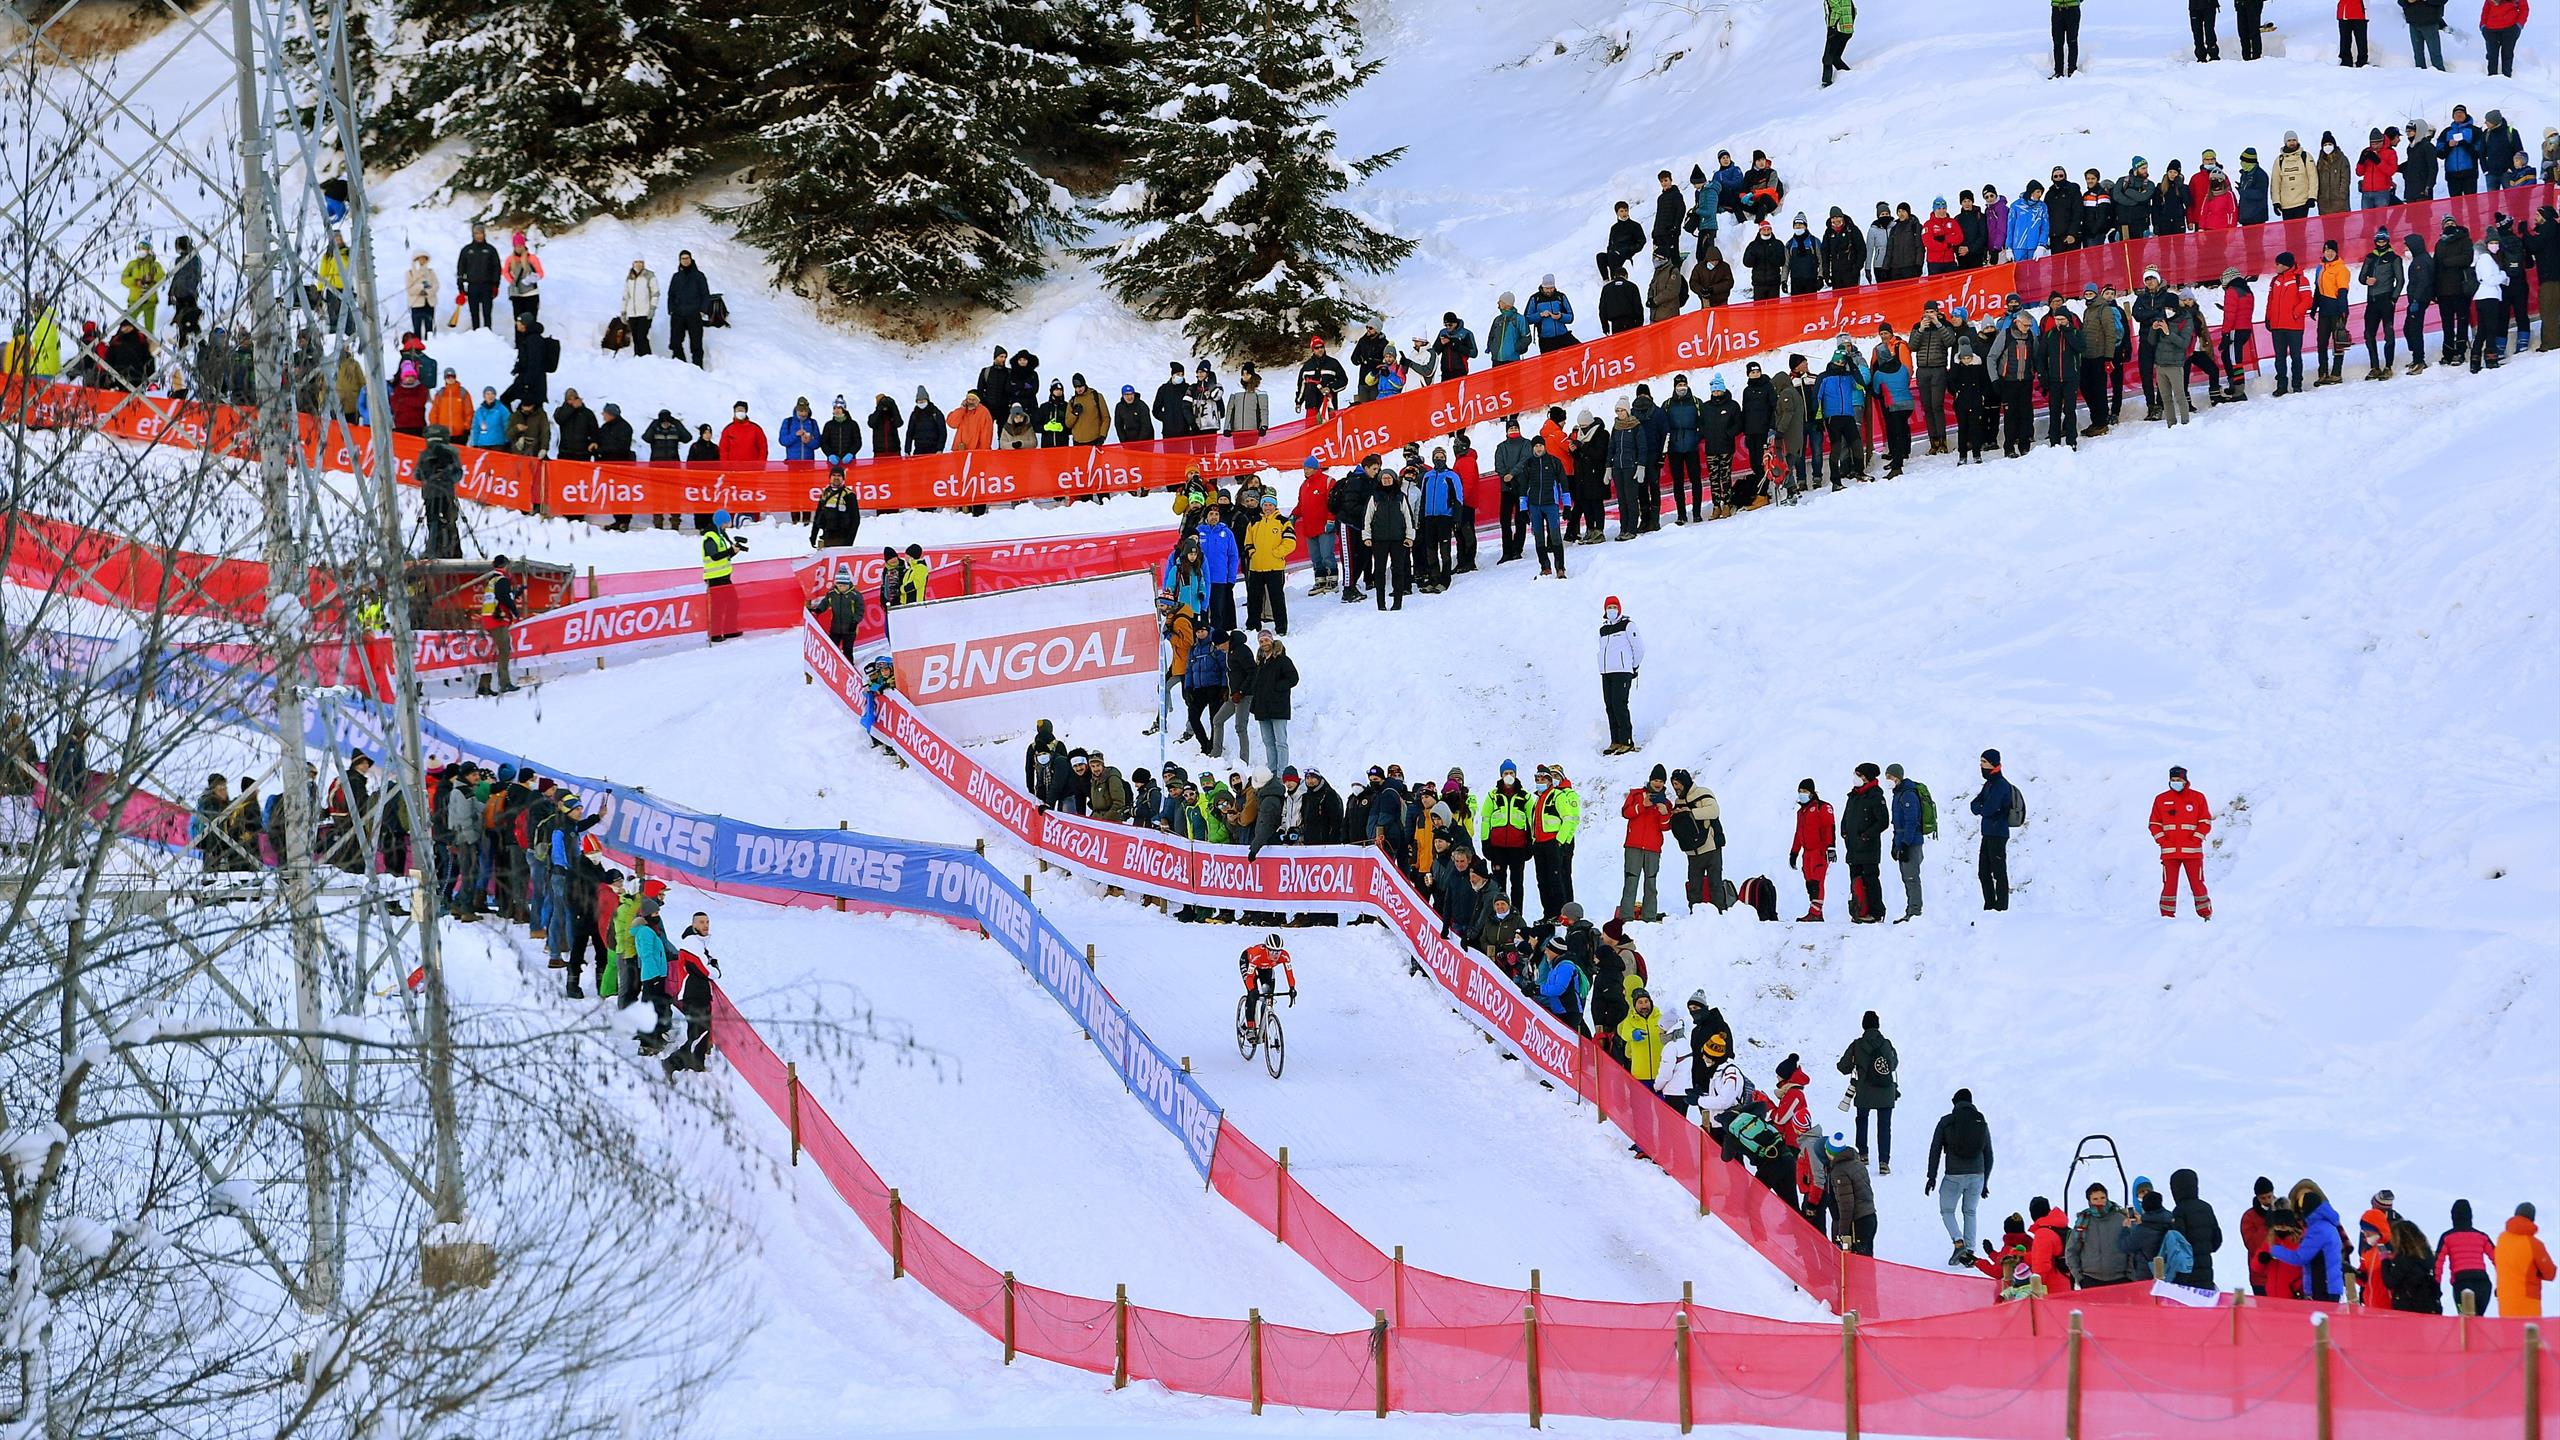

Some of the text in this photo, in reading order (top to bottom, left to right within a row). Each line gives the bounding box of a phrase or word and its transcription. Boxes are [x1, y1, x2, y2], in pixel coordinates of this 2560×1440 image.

[1677, 311, 1760, 360] ethias
[1553, 347, 1635, 392] ethias
[1430, 379, 1513, 428] ethias
[1197, 452, 1269, 474] thias
[1311, 416, 1391, 464] ethias
[460, 451, 519, 498] thias
[562, 466, 644, 510] ethias
[684, 473, 767, 507] ethias
[809, 469, 892, 502] eias
[932, 452, 1015, 502] ethias
[1058, 446, 1143, 491] ethias
[562, 602, 692, 646] B!NGOAL
[918, 627, 1135, 695] B!NGOAL
[896, 711, 955, 781] B!NGOAL
[967, 768, 1030, 835] B!NGOAL
[619, 799, 715, 869] TIRES
[736, 833, 906, 893] TOYO TIRES
[1123, 840, 1189, 885] B!NGOAL
[1201, 853, 1263, 892] B!NGOAL
[1278, 857, 1354, 893] B!NGOAL
[926, 859, 1031, 953] TOYO TIRES
[1038, 927, 1127, 1067] TOYO TIRES
[1466, 965, 1514, 1029] B!NGOAL
[1520, 1016, 1573, 1079] B!NGOAL
[1128, 1030, 1221, 1167] TOYO TIRES
